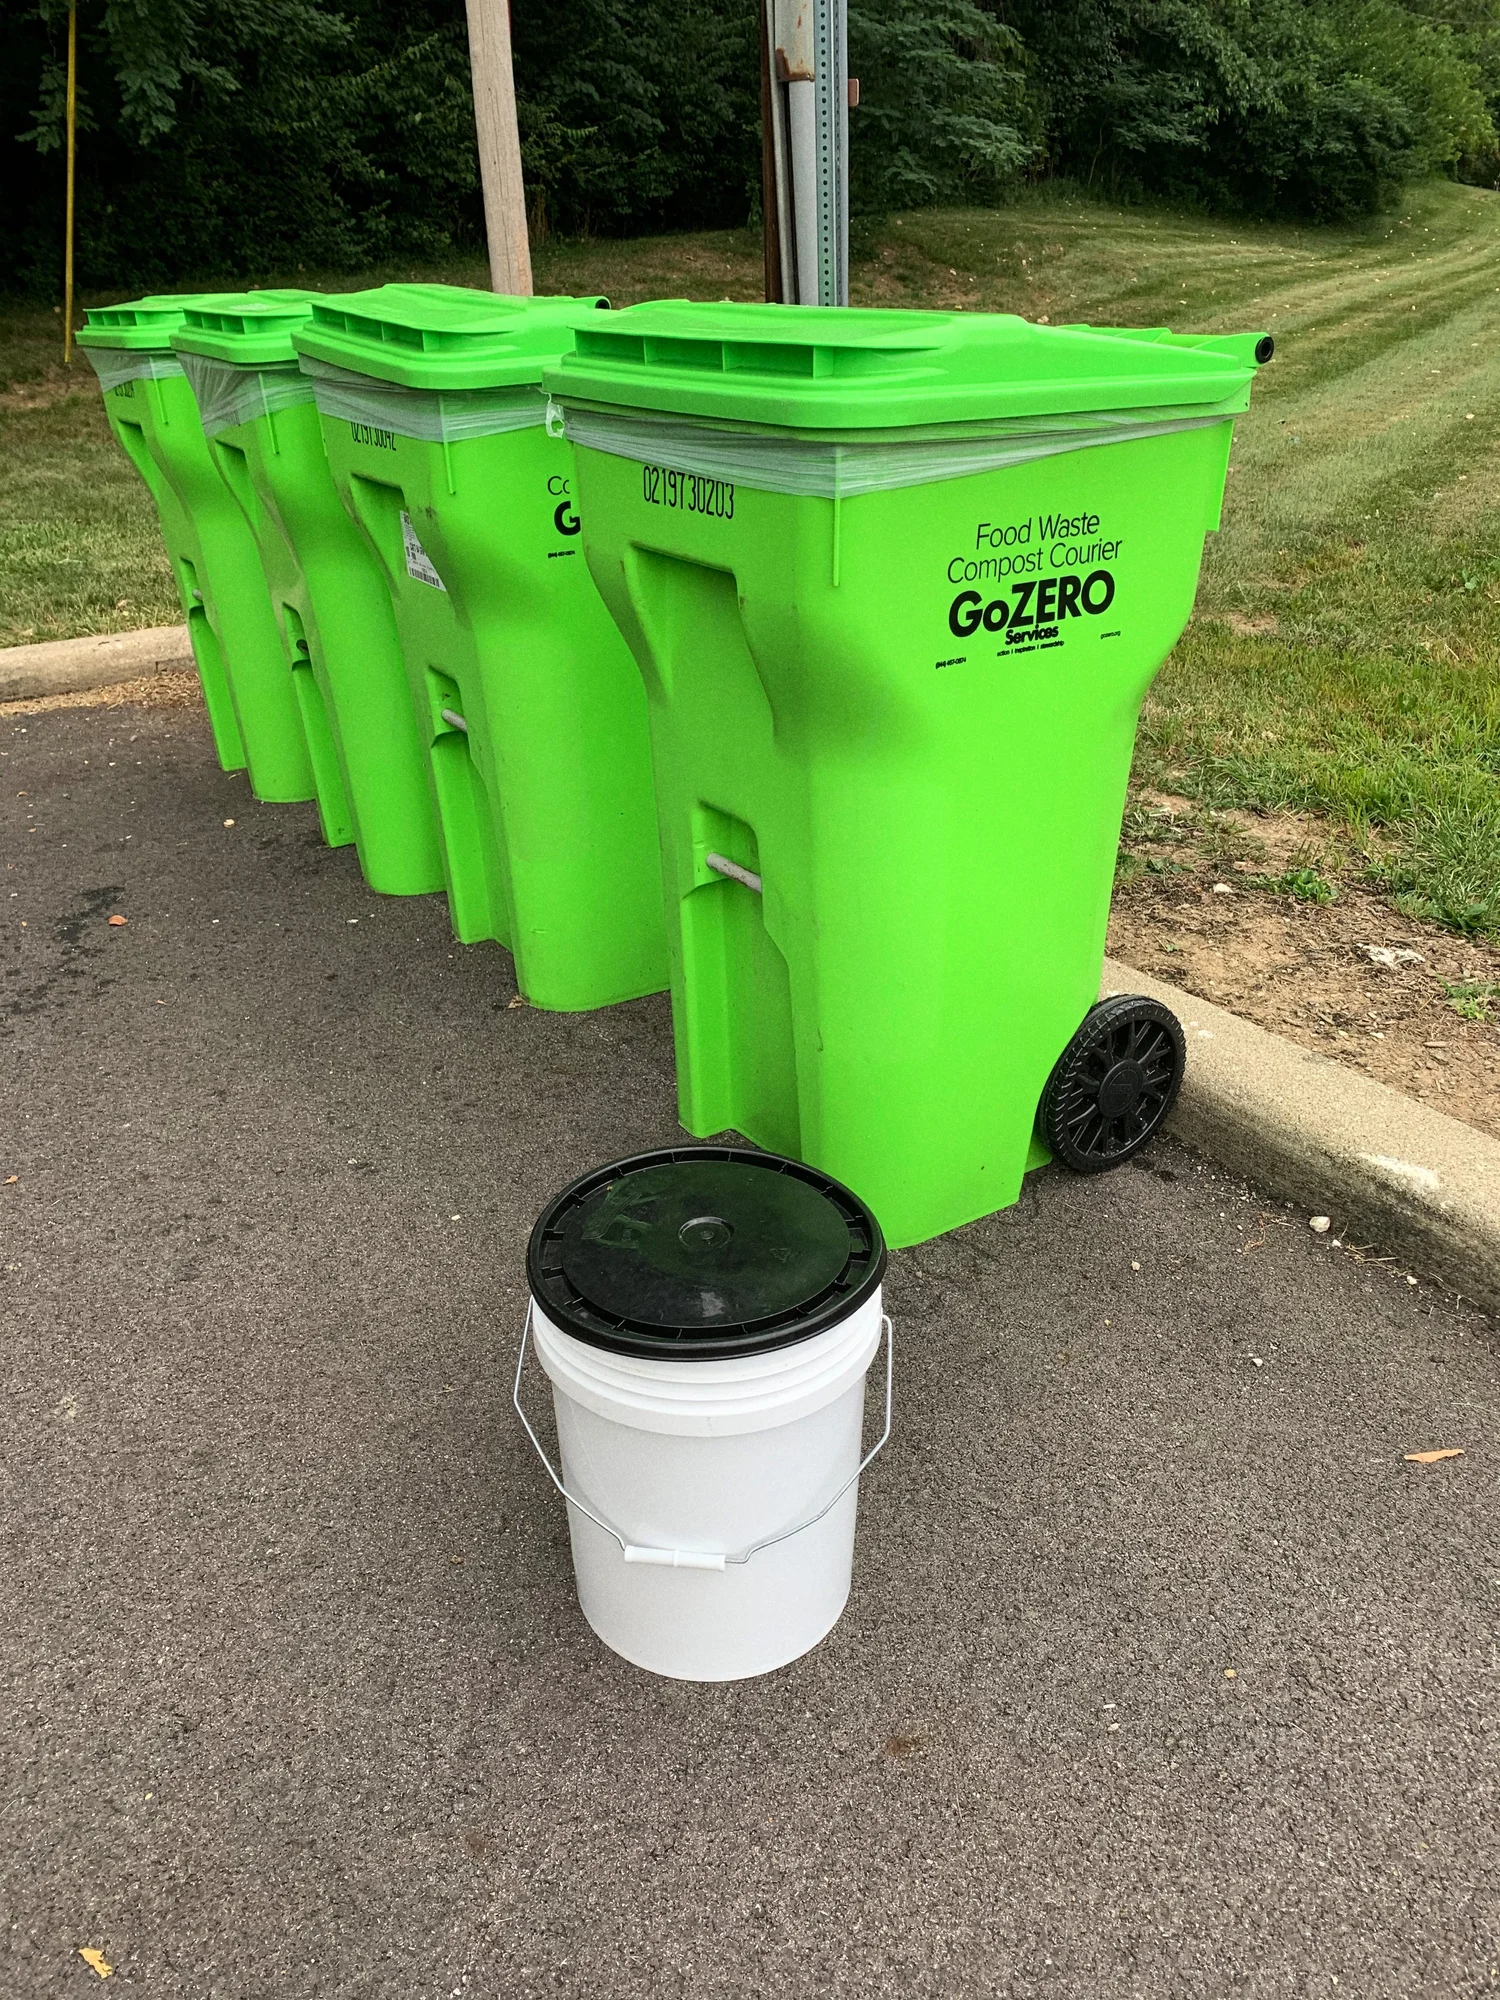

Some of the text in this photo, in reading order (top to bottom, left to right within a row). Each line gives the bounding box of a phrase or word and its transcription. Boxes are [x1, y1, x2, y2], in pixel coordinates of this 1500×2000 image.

[643, 465, 734, 519] 0219730203
[976, 512, 1100, 550] Food Waste
[947, 538, 1123, 583] Compost Courier
[948, 569, 1115, 638] GoZERO
[1005, 625, 1059, 646] Services
